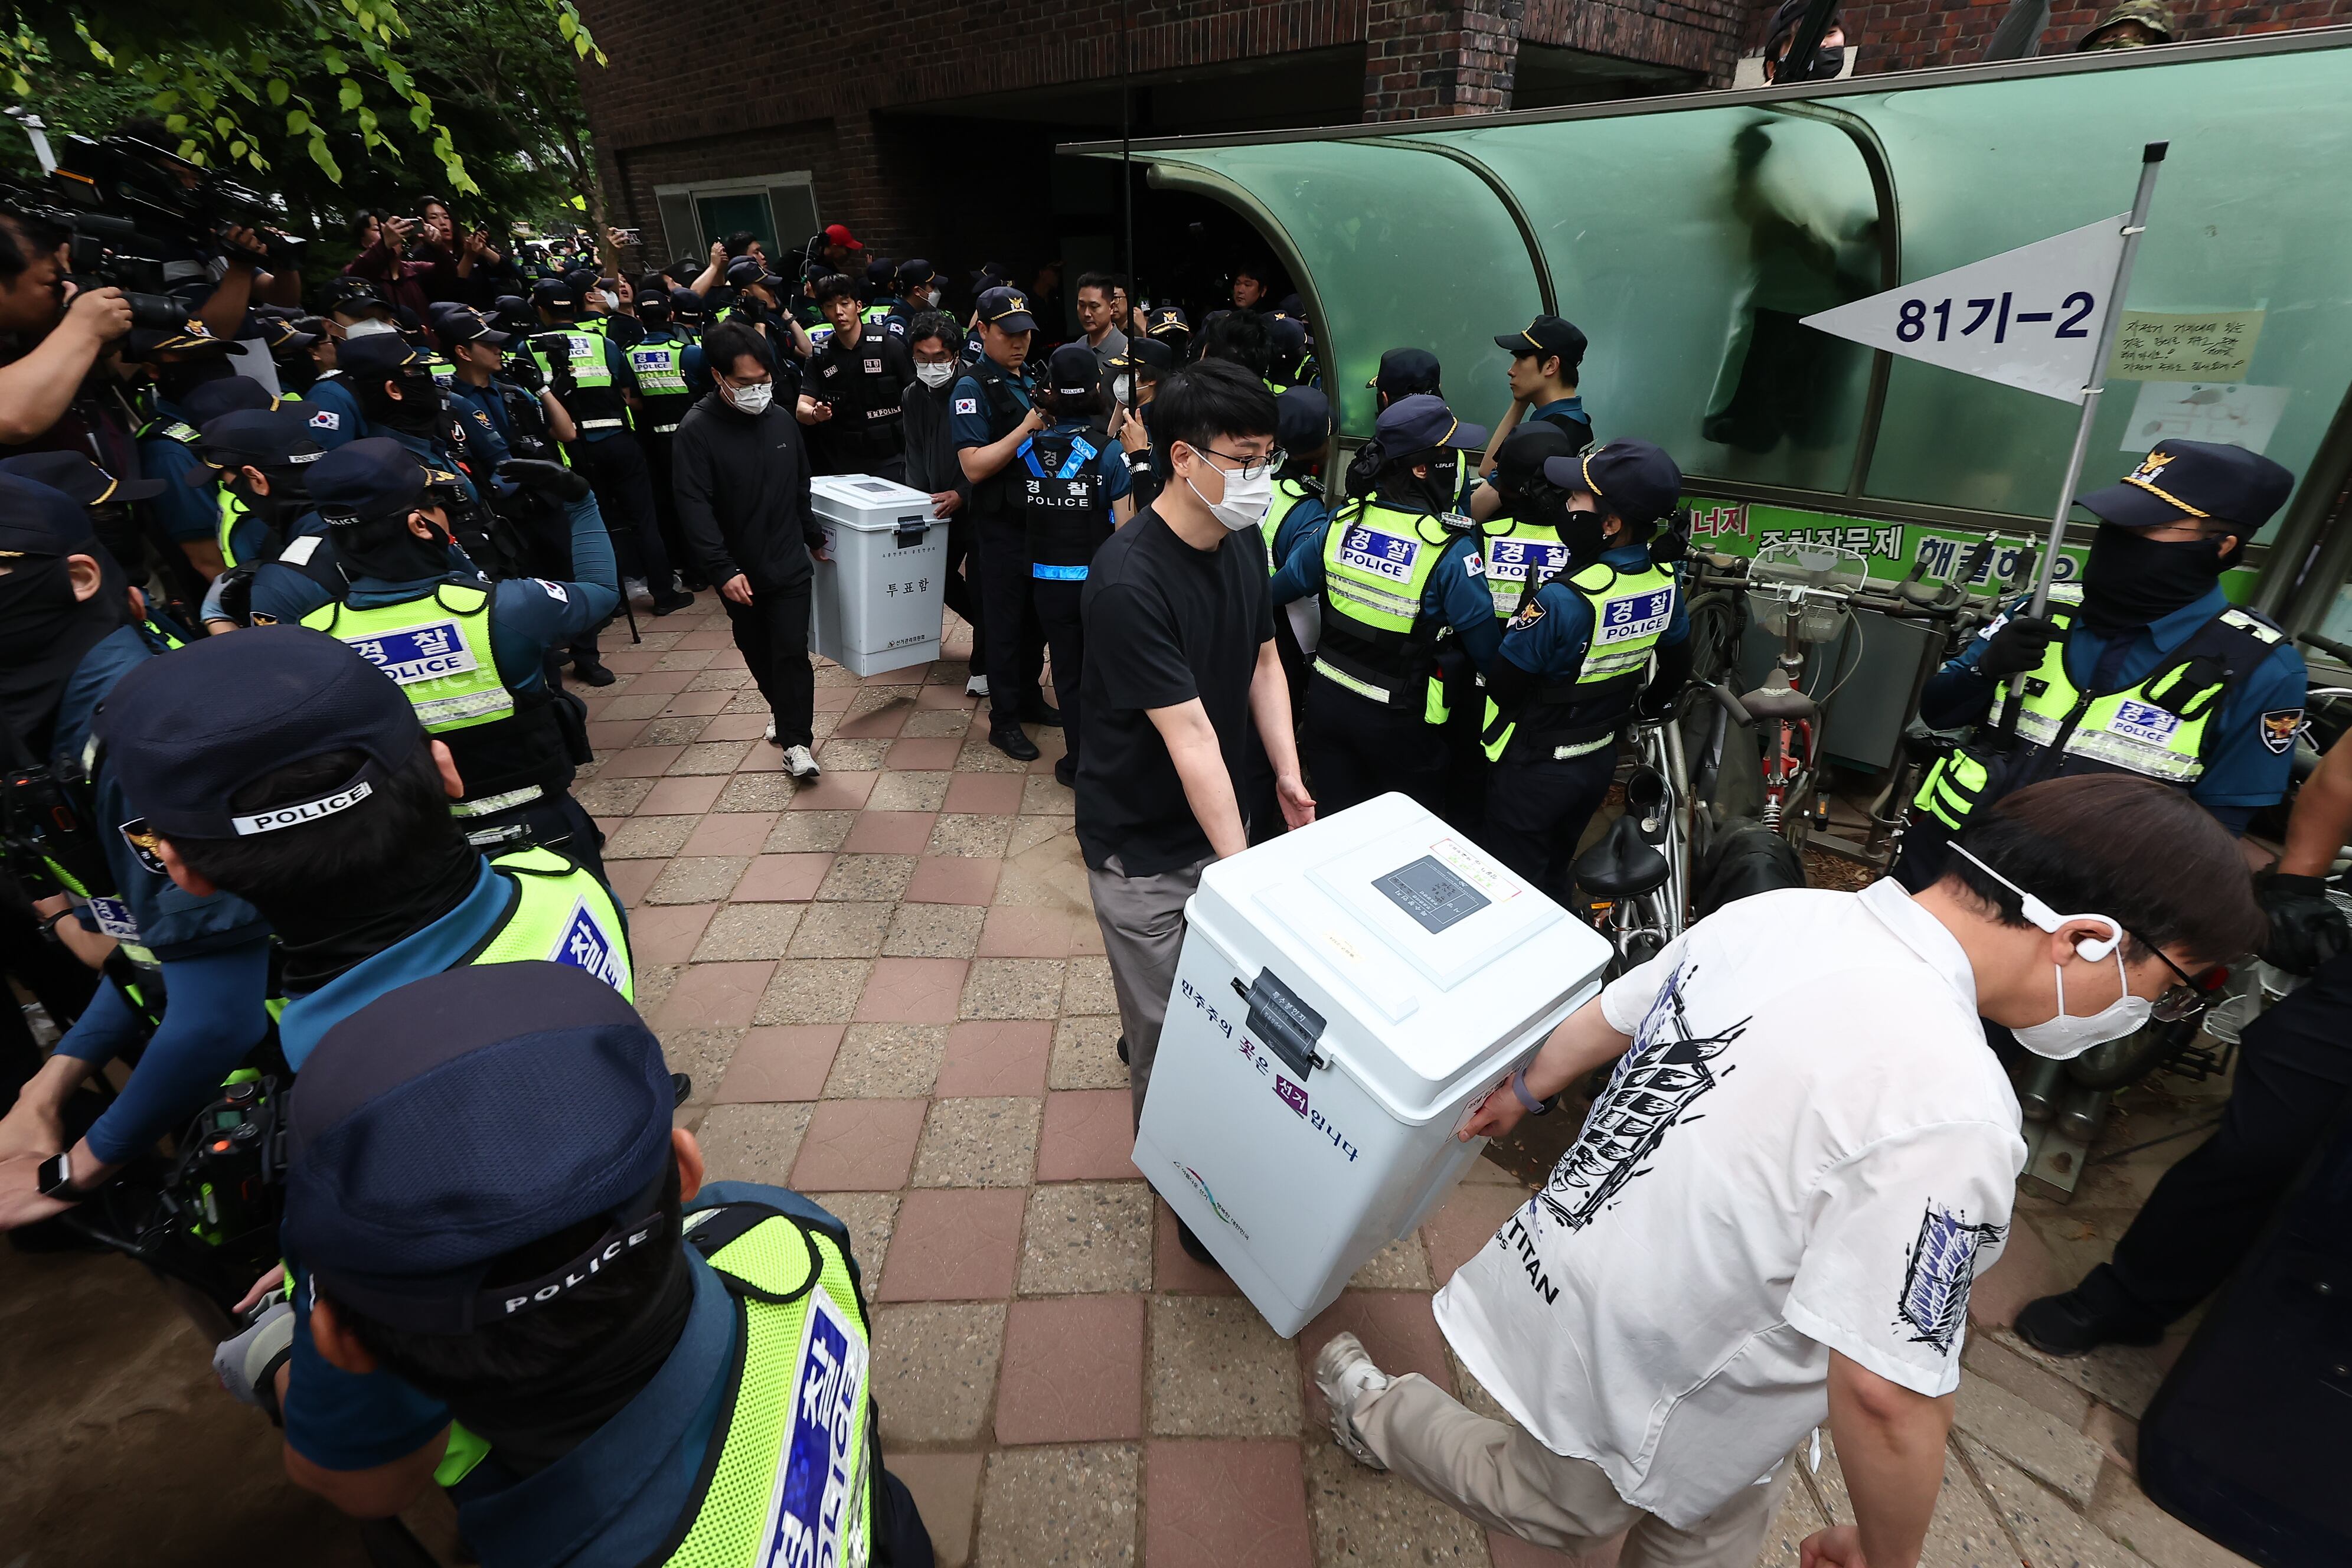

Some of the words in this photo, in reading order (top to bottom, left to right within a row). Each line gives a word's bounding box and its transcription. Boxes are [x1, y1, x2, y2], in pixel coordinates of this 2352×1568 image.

[1896, 291, 2095, 344] 81기-2
[636, 353, 666, 362] 경찰
[1026, 480, 1089, 495] 경찰
[1027, 495, 1089, 507] POLICE
[1350, 530, 1410, 563] 경찰
[1501, 543, 1571, 568] 경찰
[1342, 550, 1403, 577] POLICE
[886, 577, 929, 598] 투표함
[1612, 593, 1667, 623] 경찰
[1606, 618, 1663, 640] POLICE
[349, 628, 450, 665] 경찰
[384, 656, 460, 680] OLICE
[2114, 722, 2166, 743] POLICE
[2124, 703, 2175, 732] 경찰
[254, 785, 365, 829] POLICE
[570, 920, 604, 975] 찰
[1272, 991, 1306, 1022] 특수봉인지
[1182, 978, 1233, 1039] 민주주의
[1238, 1035, 1269, 1076] 꽃은
[505, 1229, 648, 1314] POLICE
[1508, 1216, 1560, 1306] TITAN
[821, 1367, 856, 1568] OLICE
